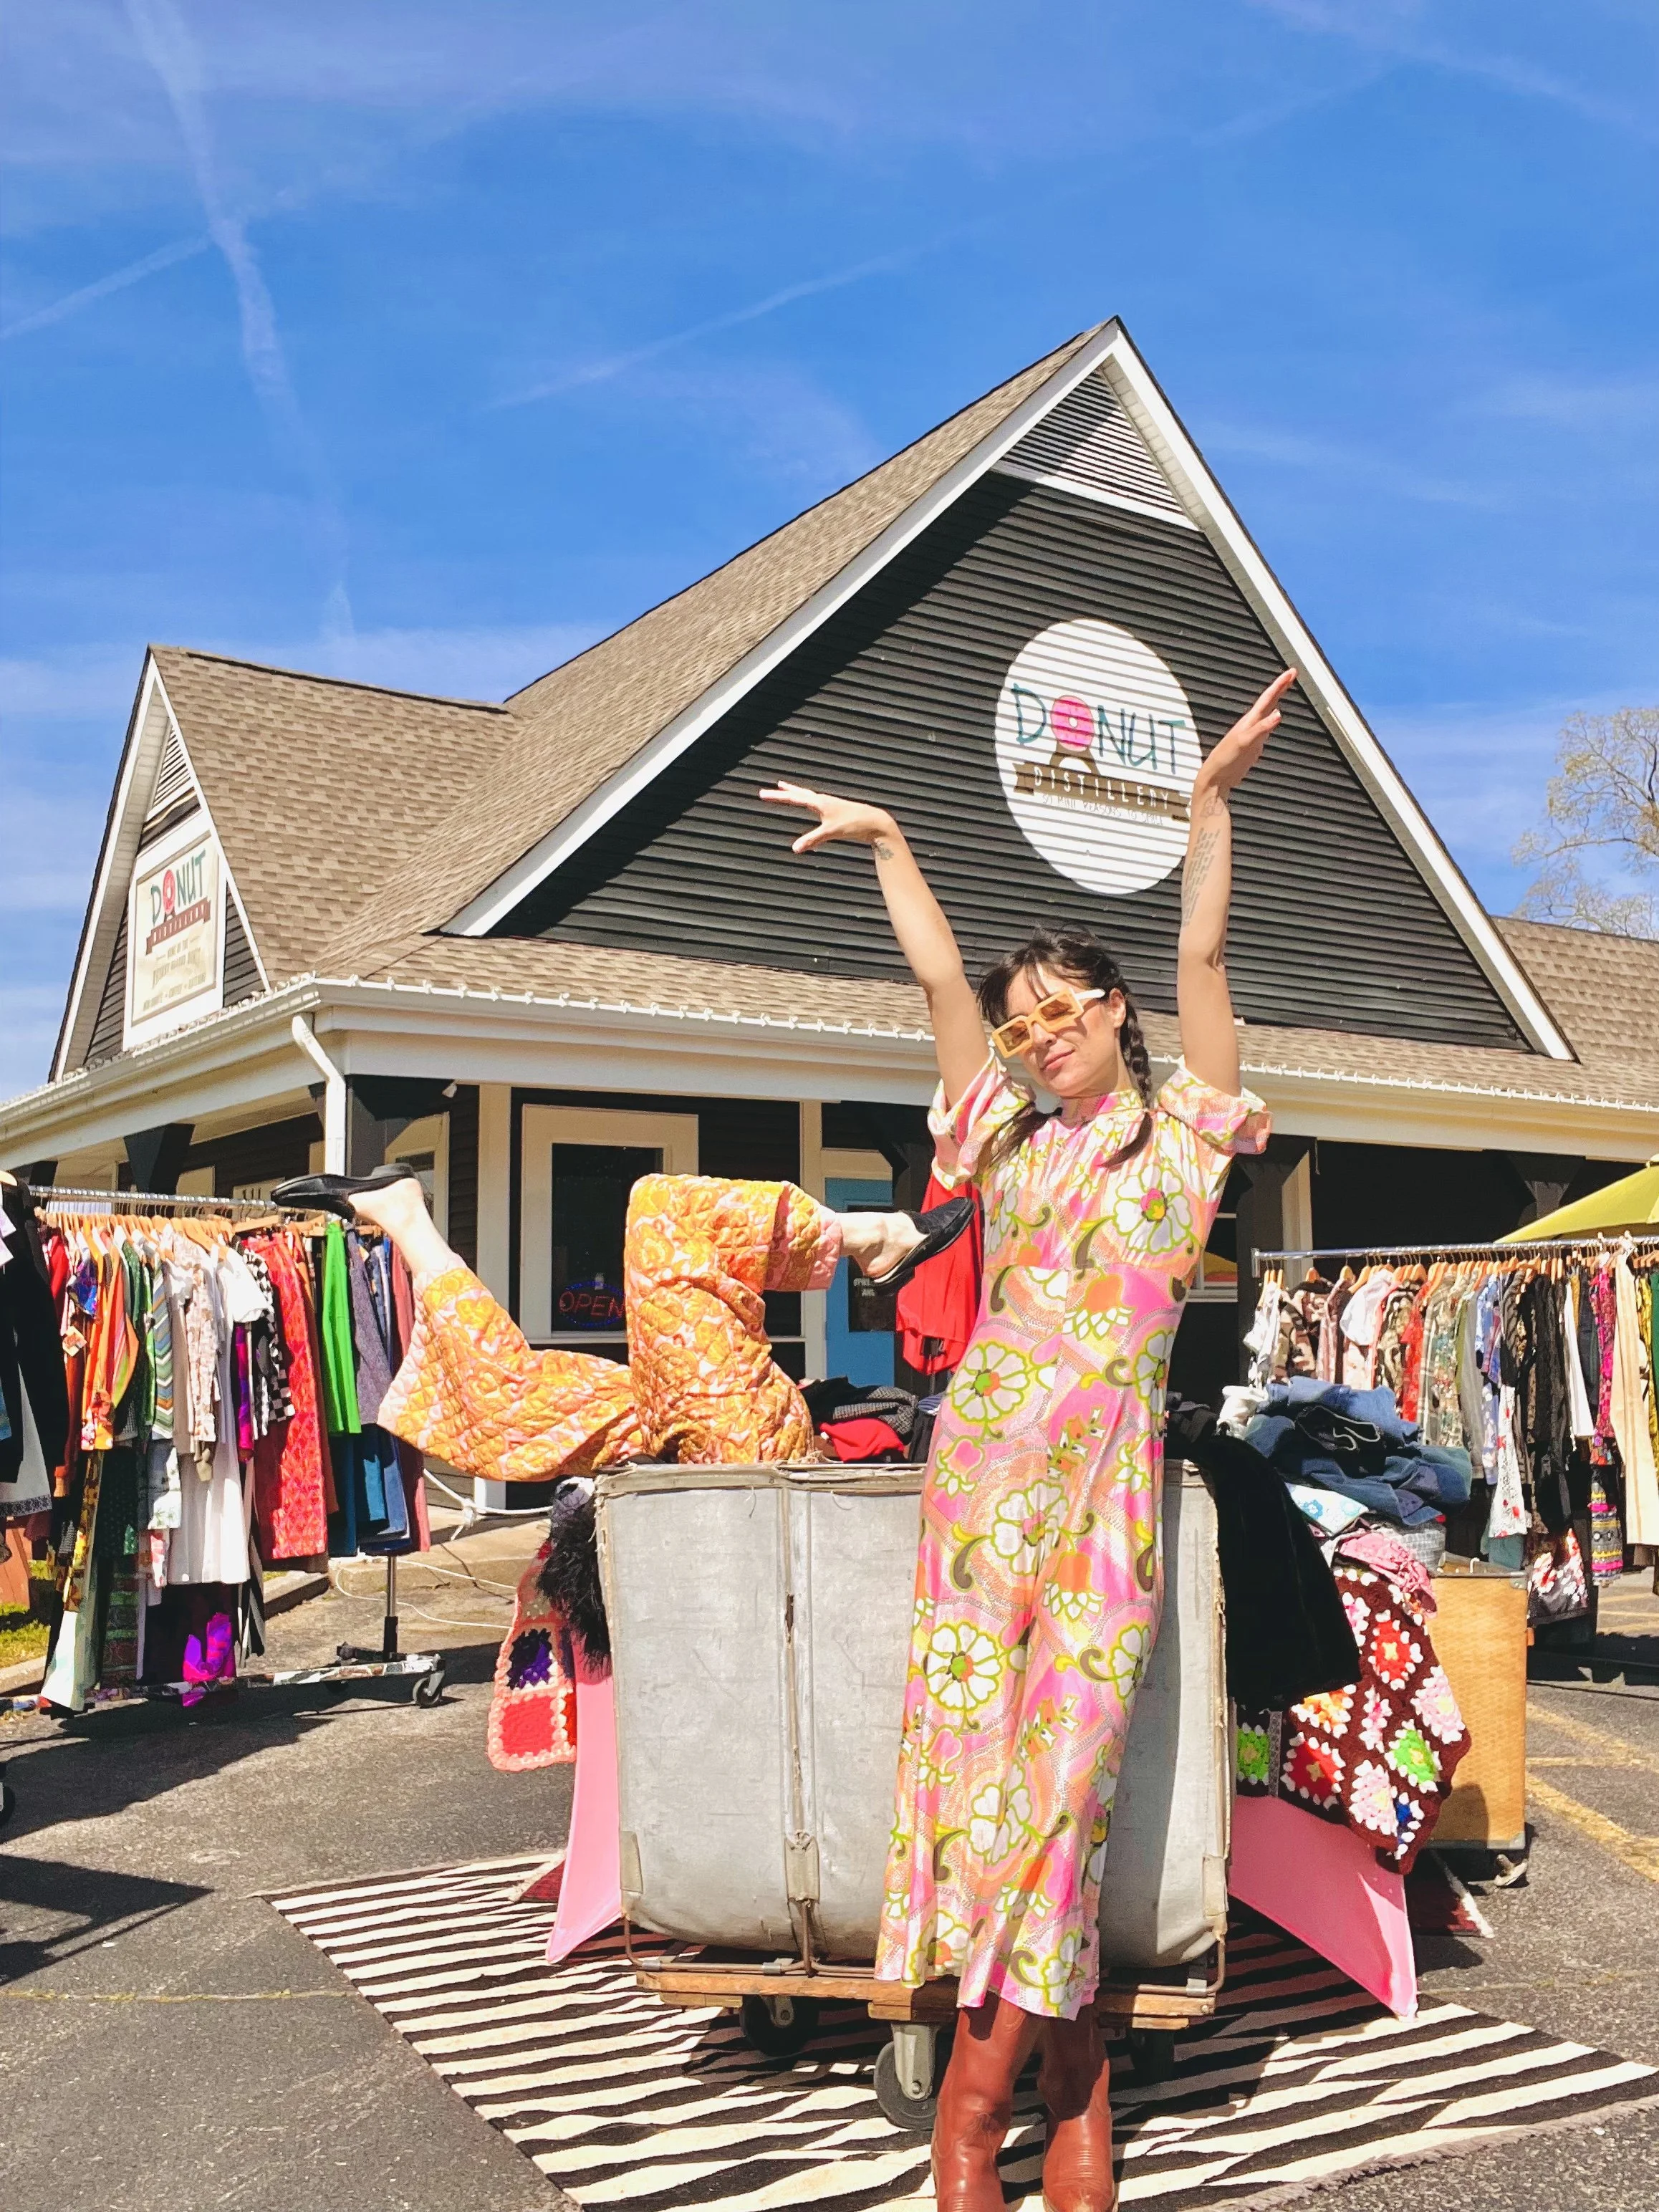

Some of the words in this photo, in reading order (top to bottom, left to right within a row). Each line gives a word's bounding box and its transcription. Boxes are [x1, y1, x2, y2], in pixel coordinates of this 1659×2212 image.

[1011, 683, 1186, 774] DONUT
[1034, 766, 1169, 810] DISTILLERY
[151, 848, 206, 926] DONUT
[559, 1291, 625, 1318] OPEN
